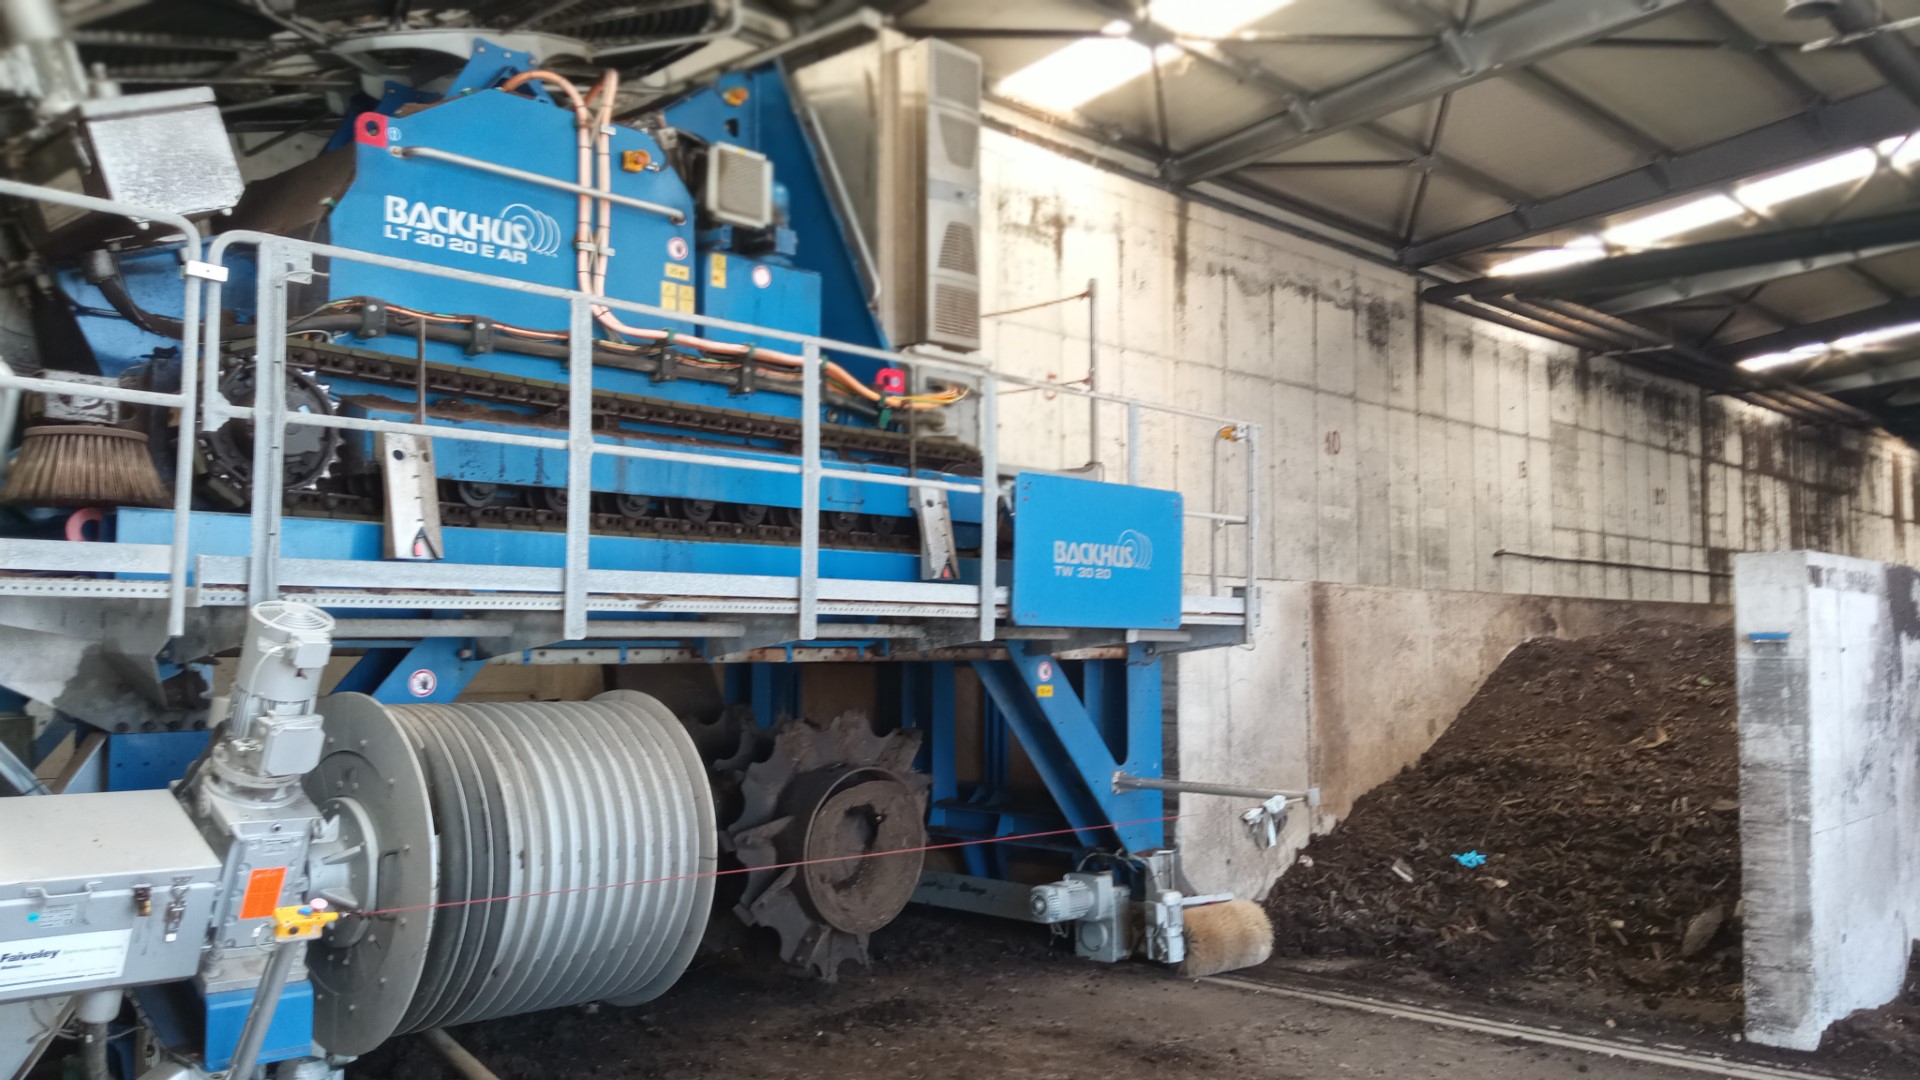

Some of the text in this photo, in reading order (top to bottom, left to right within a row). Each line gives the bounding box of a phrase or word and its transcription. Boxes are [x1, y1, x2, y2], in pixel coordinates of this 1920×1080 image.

[385, 195, 528, 250] BACKHUS
[384, 225, 528, 265] LT 30 20 E AR
[1053, 540, 1133, 568] BACKHUS
[1053, 565, 1074, 577] TW
[0, 949, 61, 963] Faiveley
